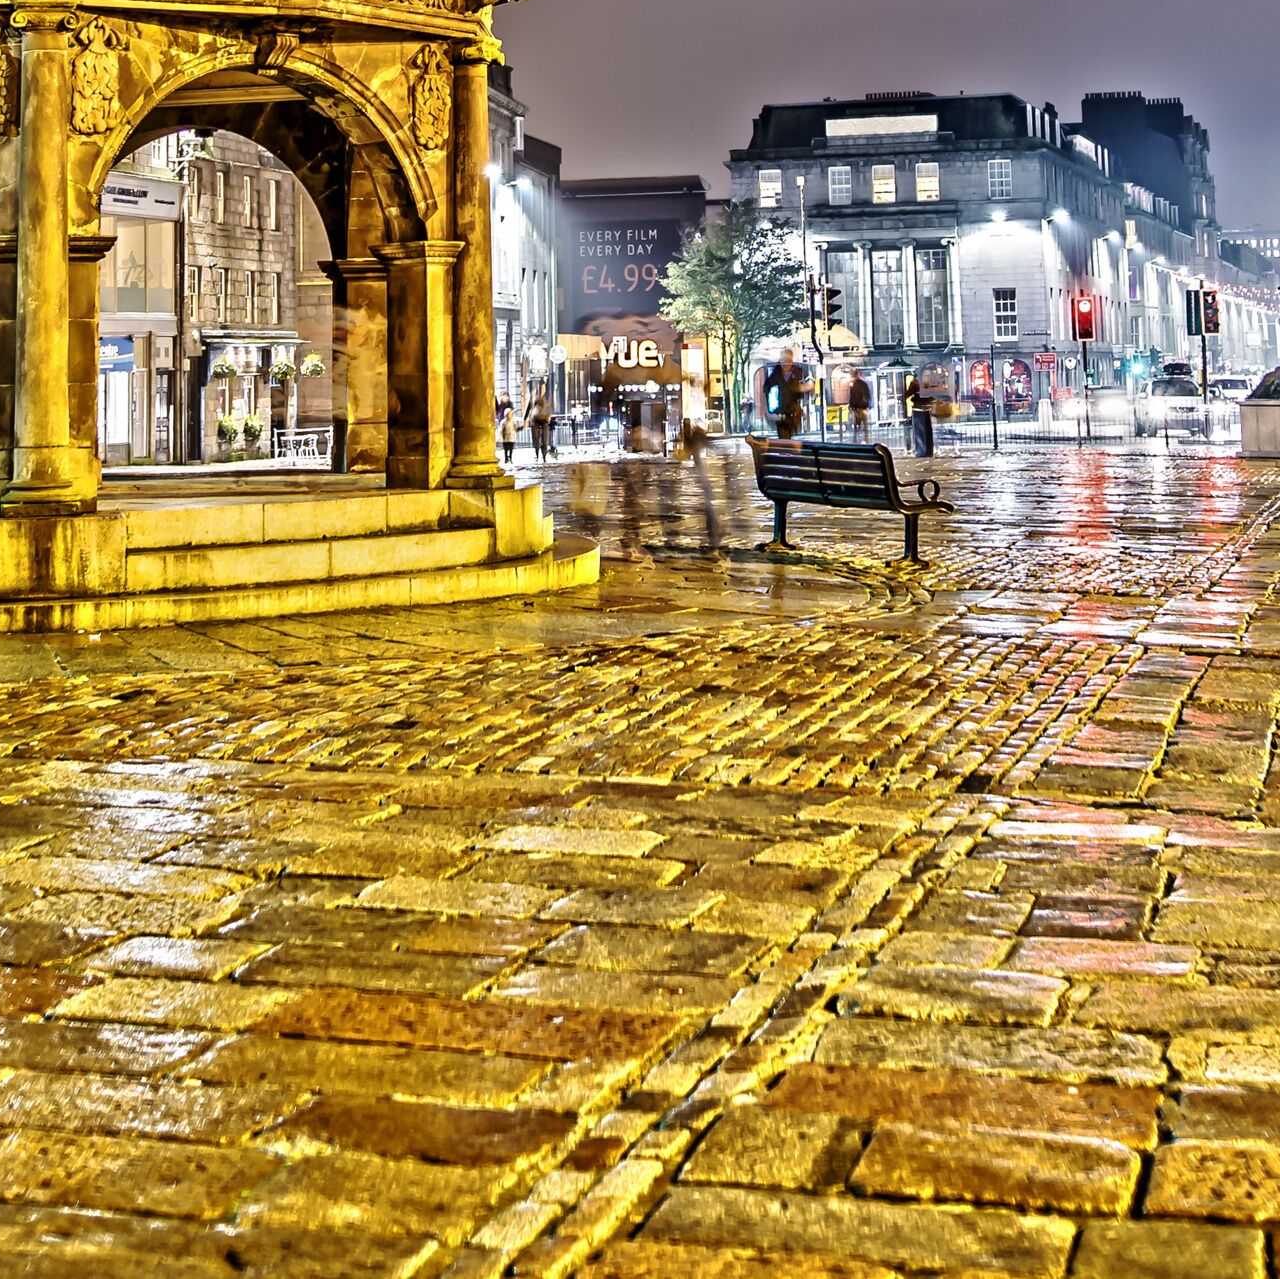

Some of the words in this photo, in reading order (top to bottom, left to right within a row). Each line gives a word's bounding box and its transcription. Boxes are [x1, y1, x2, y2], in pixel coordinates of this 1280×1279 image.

[580, 230, 621, 242] EVERY
[627, 229, 657, 240] FILM
[580, 245, 622, 257] EVERY
[627, 244, 654, 256] DAY
